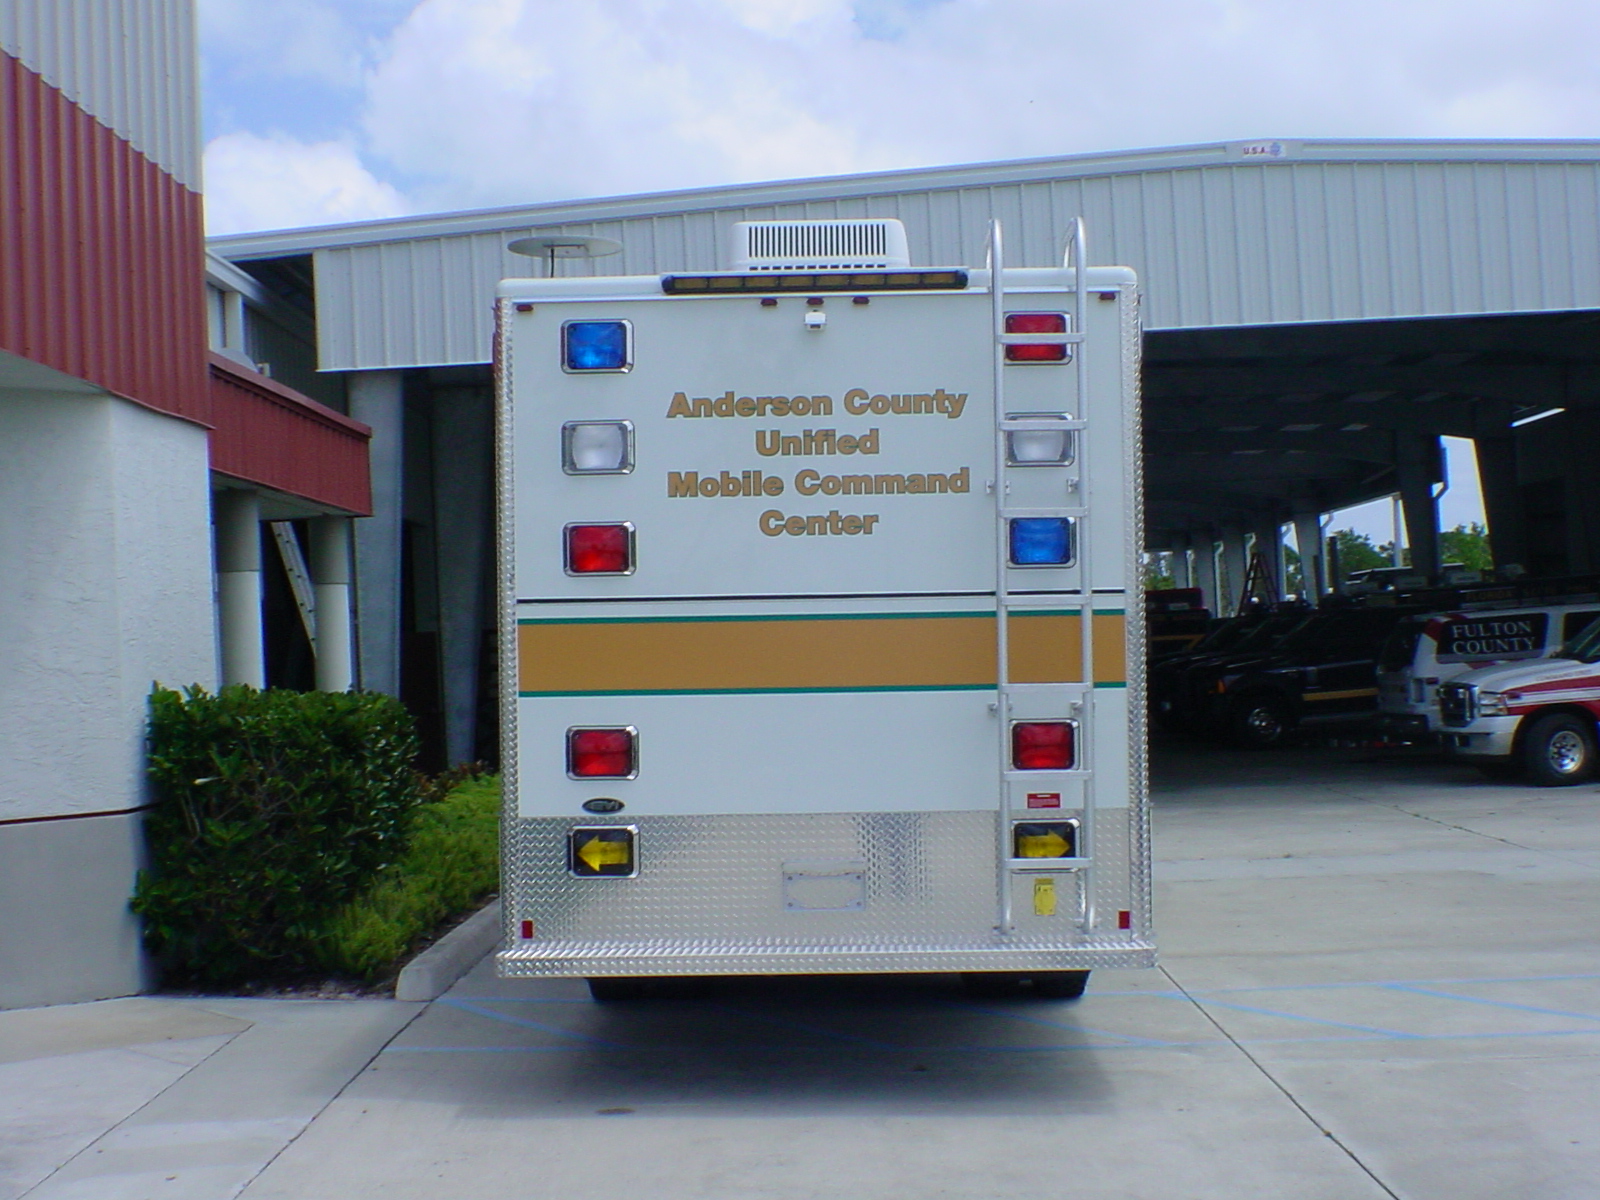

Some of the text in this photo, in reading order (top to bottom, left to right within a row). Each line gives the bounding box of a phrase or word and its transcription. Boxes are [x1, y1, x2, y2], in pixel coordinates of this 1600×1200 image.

[666, 388, 968, 419] Anderson County
[756, 428, 880, 456] Unified
[667, 467, 970, 498] Mobile Command
[759, 510, 879, 537] Center
[1452, 621, 1531, 638] FULTON
[1452, 637, 1535, 654] COUNTY
